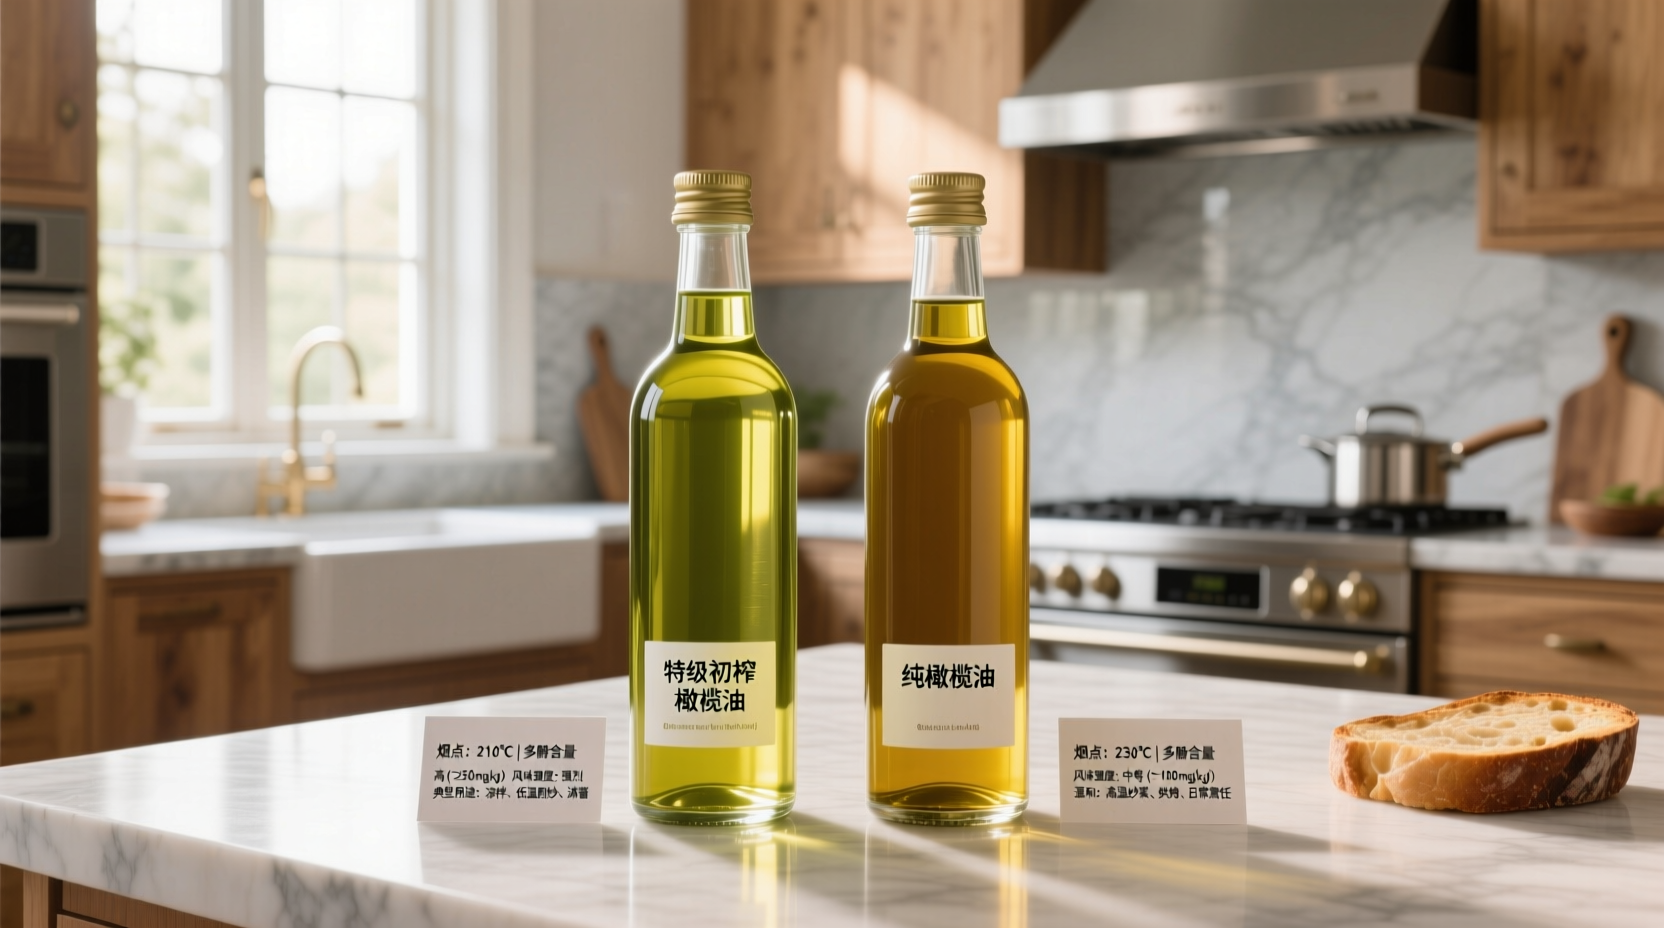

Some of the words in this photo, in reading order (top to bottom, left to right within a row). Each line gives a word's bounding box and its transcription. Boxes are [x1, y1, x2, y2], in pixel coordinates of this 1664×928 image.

[663, 659, 757, 684] 特级初榨
[901, 663, 995, 689] 纯橄榄油
[674, 687, 745, 713] 橄榄油
